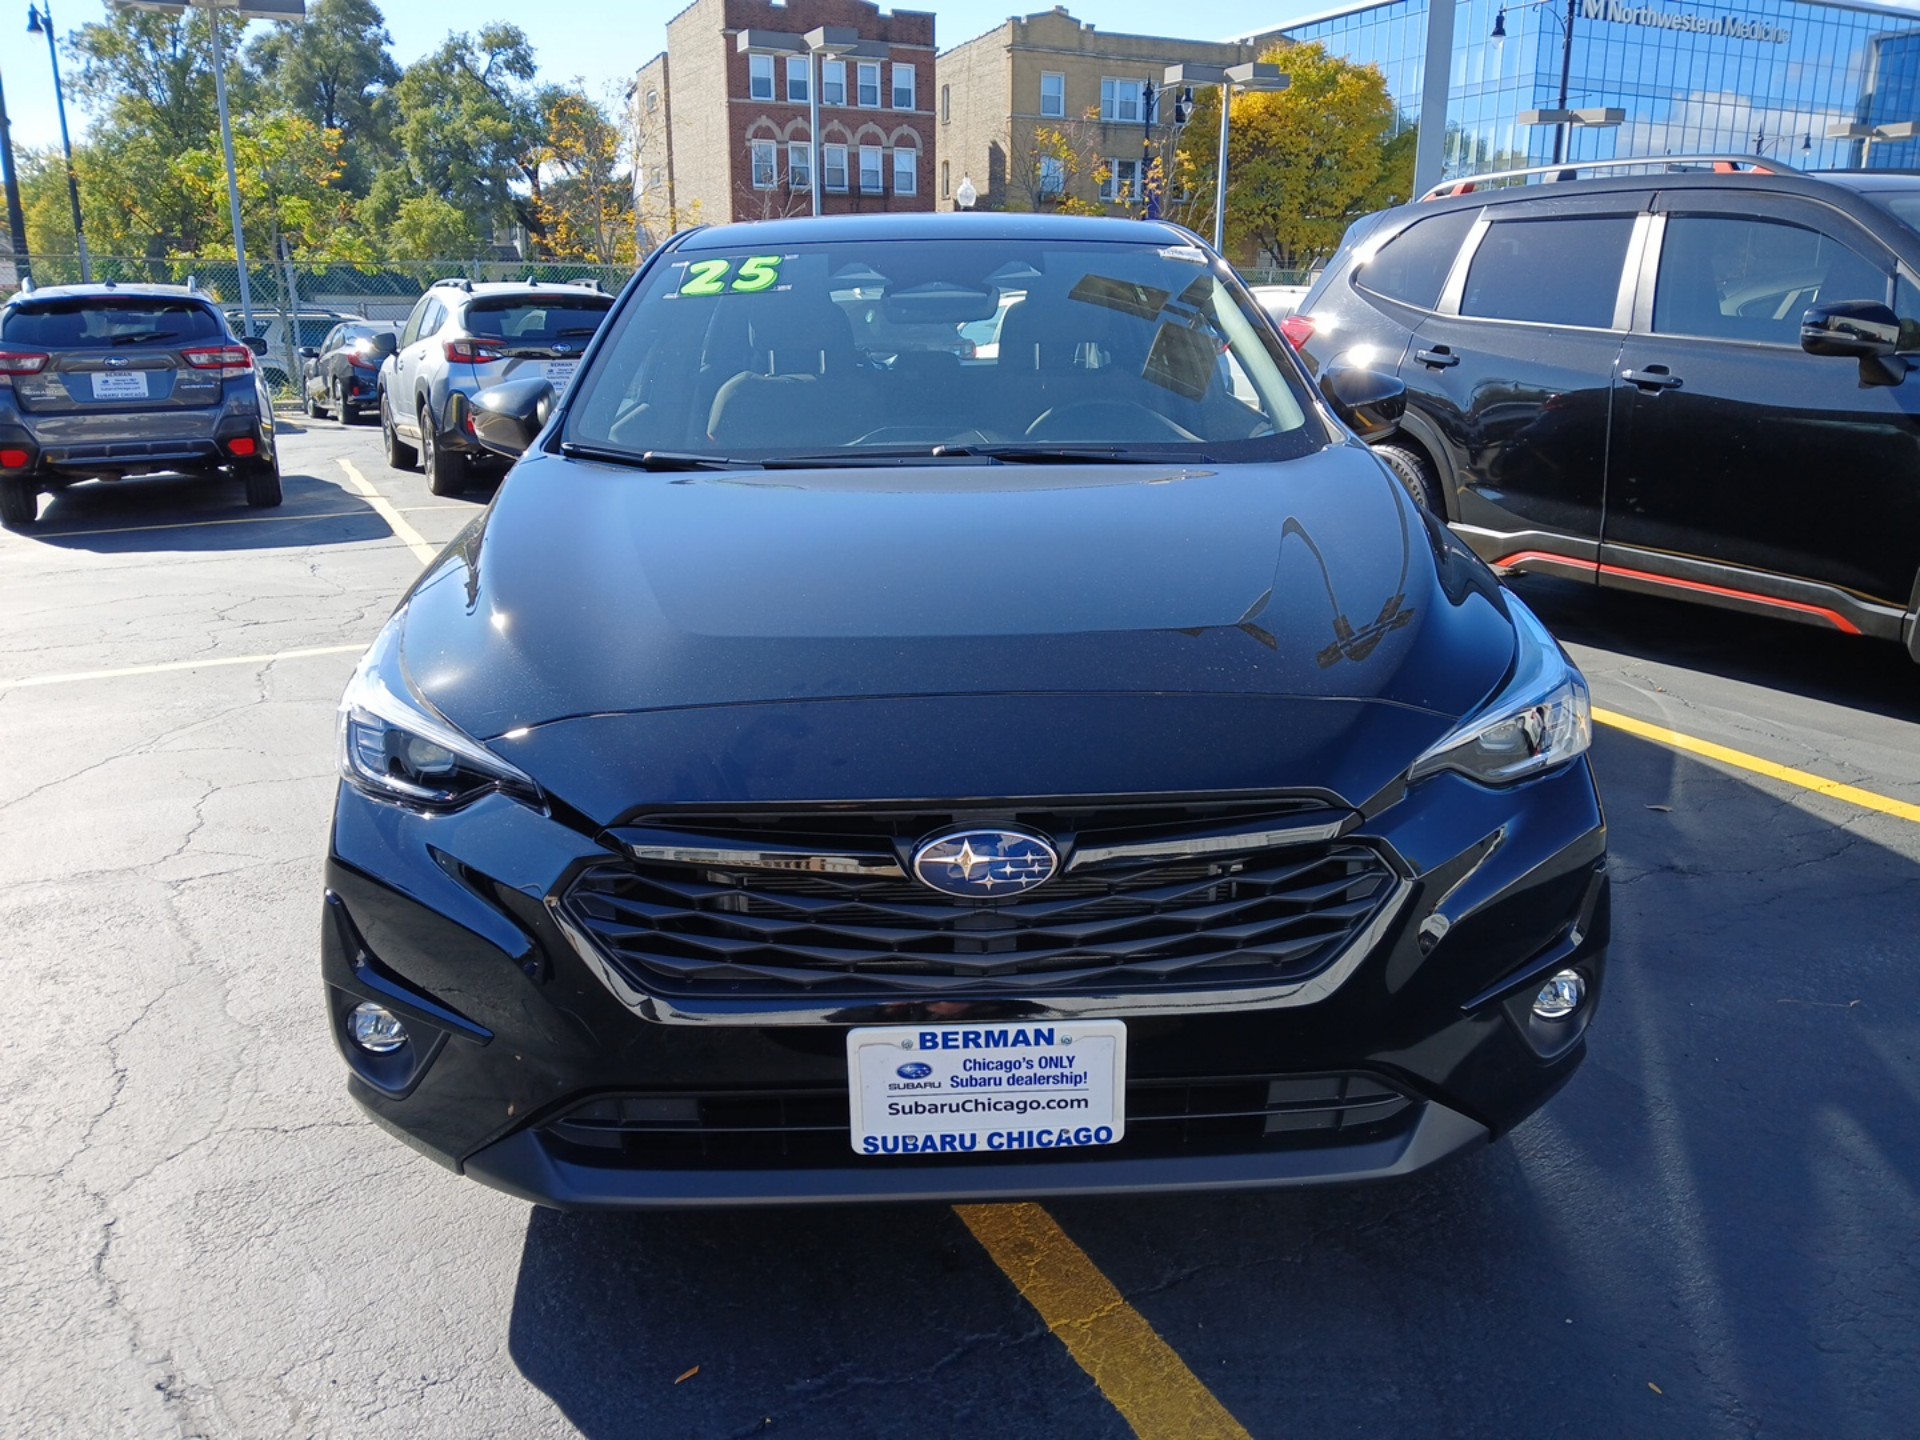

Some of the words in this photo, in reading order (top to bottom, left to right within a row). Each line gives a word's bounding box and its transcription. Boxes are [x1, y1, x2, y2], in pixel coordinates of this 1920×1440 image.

[1607, 0, 1723, 35] Northwestern
[1724, 15, 1791, 44] Medicine
[680, 255, 784, 297] 25
[919, 1027, 1055, 1050] BERMAN
[962, 1057, 1034, 1073] Chicago's
[1038, 1055, 1076, 1069] ONLY
[888, 1081, 941, 1091] SUBARU
[950, 1074, 1003, 1088] Subaru
[1006, 1071, 1088, 1087] dealership!
[887, 1097, 1089, 1116] SubaruChicago.com
[863, 1132, 977, 1154] SUBARU
[987, 1126, 1113, 1150] CHICAGO
